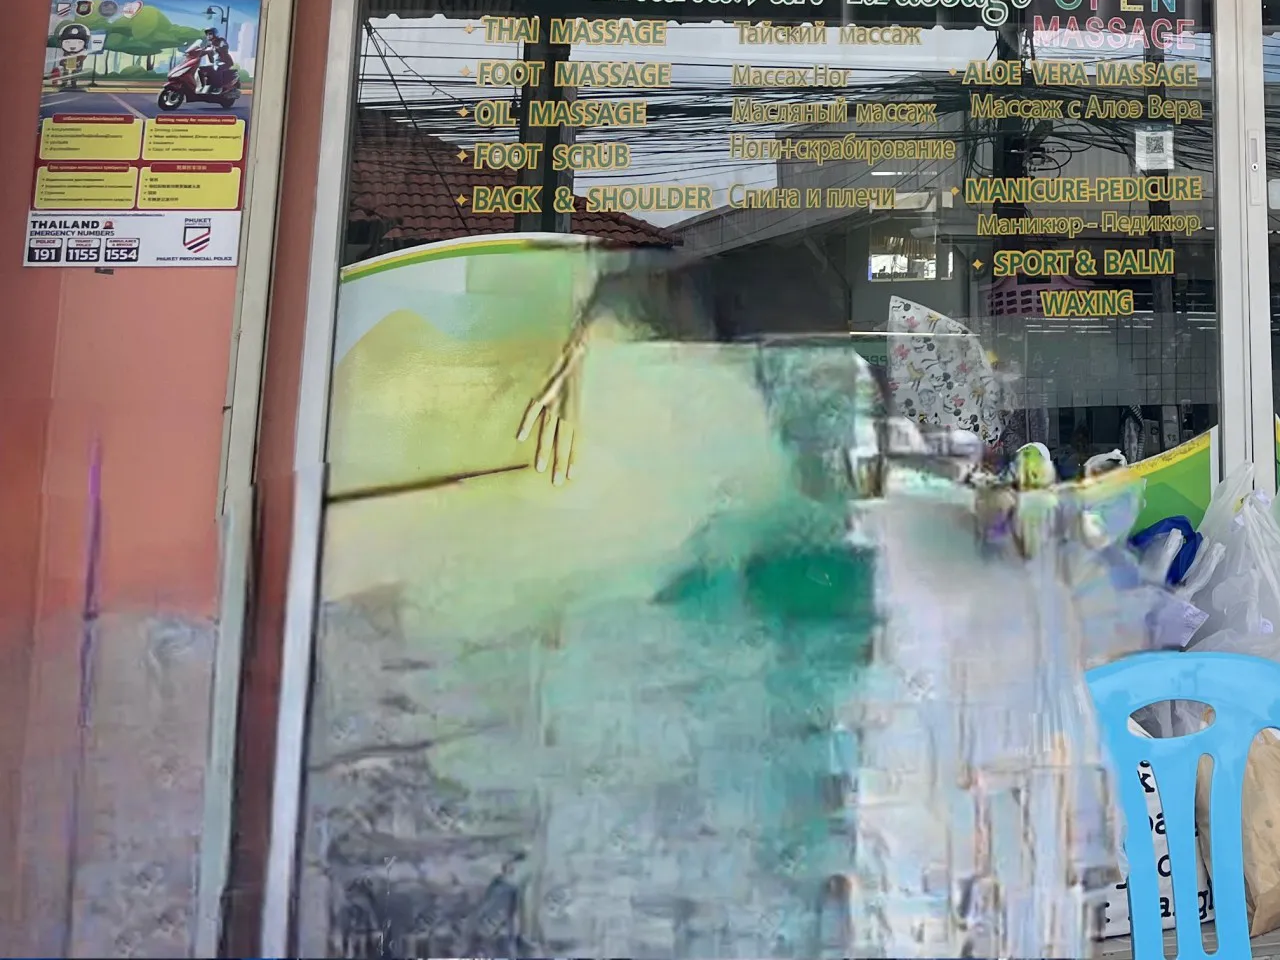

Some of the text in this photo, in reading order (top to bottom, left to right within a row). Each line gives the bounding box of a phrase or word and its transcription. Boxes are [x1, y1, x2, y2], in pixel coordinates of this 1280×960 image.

[483, 16, 667, 46] THAI MASSAGE
[733, 20, 923, 45] Тайский массаж
[1033, 14, 1196, 50] MASSAGE
[476, 60, 673, 88] FOOT MASSAGE
[813, 63, 851, 87] Ног
[962, 59, 1198, 86] ALOE VERA MASSAGE
[474, 100, 648, 127] OIL MASSAGE
[731, 96, 938, 123] Масляный массаж
[971, 94, 1203, 125] Массаж с Алоэ Вера
[474, 142, 632, 170] FOOT SCRUB
[729, 133, 956, 166] Ноги+скрабирование
[472, 185, 713, 213] BACK & SHOULDER
[728, 183, 897, 209] Спина и плечи
[965, 175, 1202, 204] MANICURE-PEDICURE
[31, 220, 100, 229] THAILAND
[977, 213, 1084, 238] Маникюр
[1101, 210, 1201, 237] Педикюр
[34, 249, 56, 260] 191
[68, 249, 98, 260] 1155
[106, 249, 137, 260] 1554
[993, 248, 1175, 276] SPORT & BALM
[1039, 288, 1134, 317] WAXING
